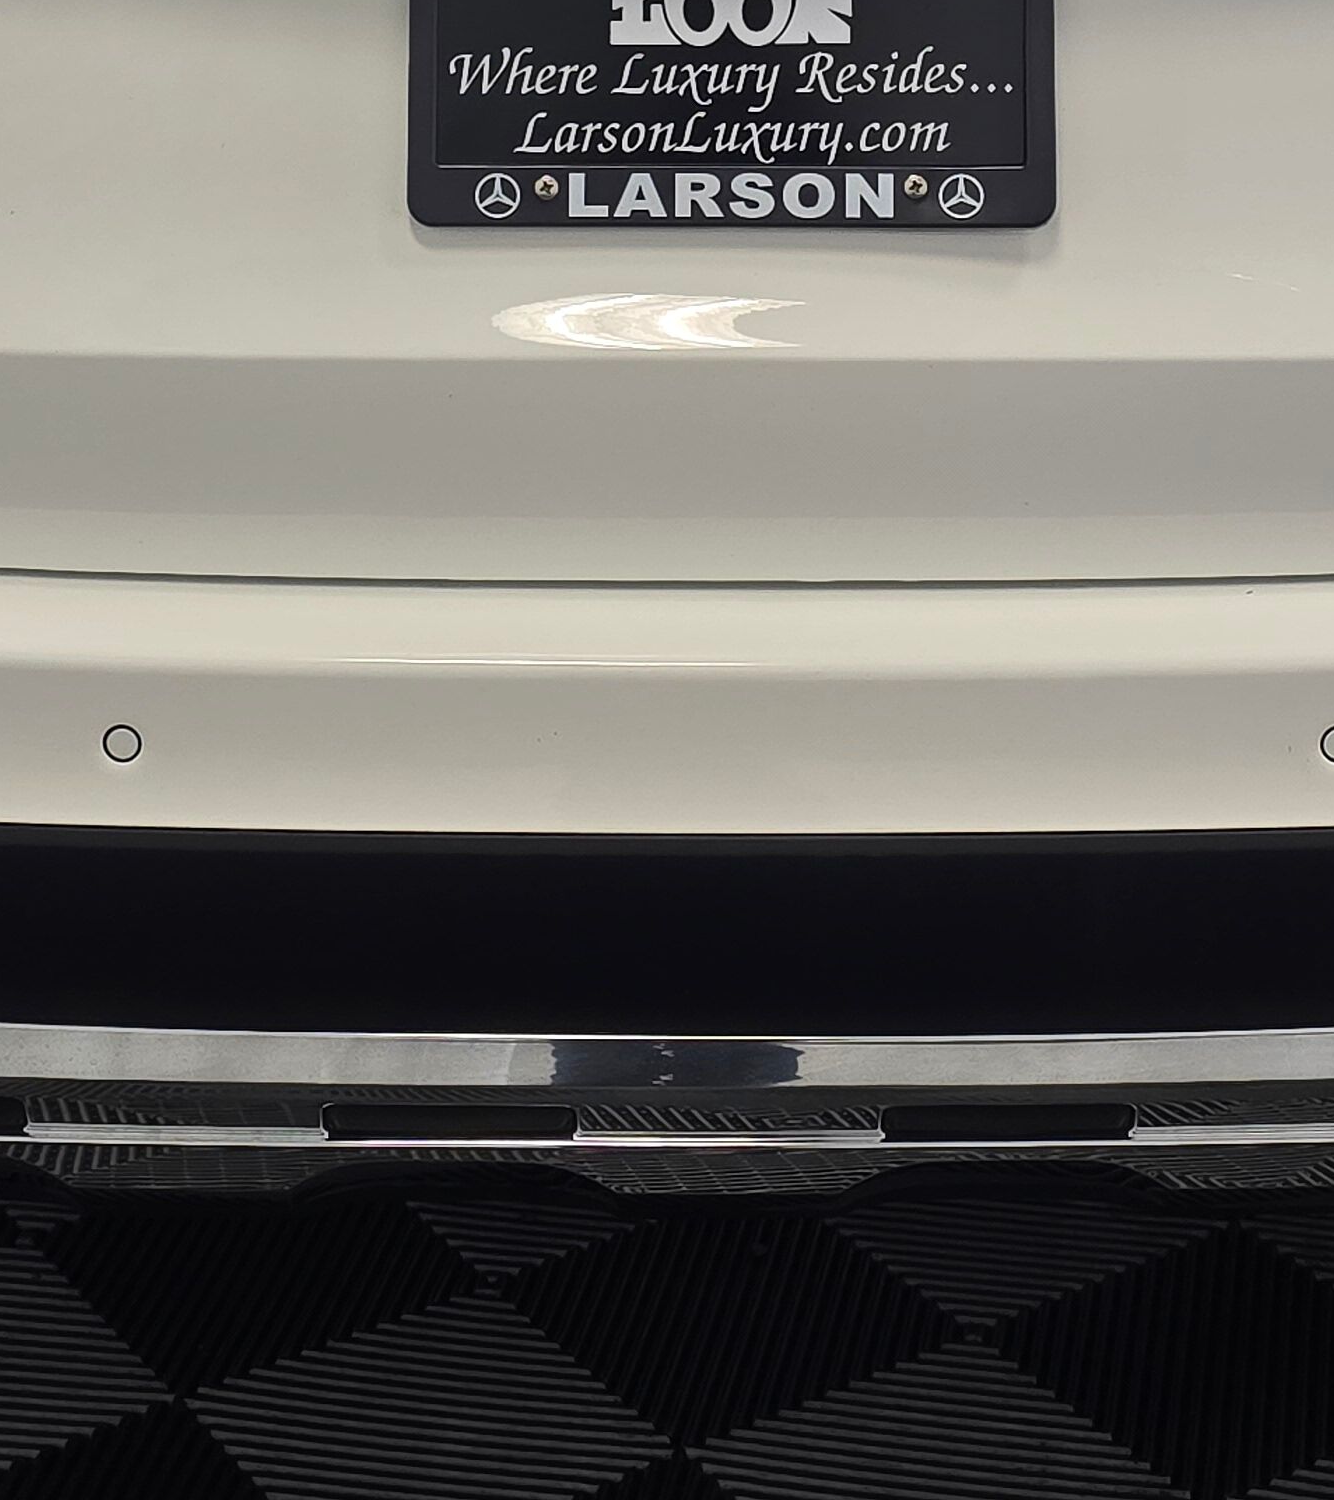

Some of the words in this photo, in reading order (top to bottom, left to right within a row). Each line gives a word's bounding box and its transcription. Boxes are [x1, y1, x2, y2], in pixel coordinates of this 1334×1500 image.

[448, 47, 598, 96] Where
[612, 53, 782, 112] Luxury
[795, 47, 1015, 103] Resides...
[513, 112, 951, 166] LarsonLuxury.com
[568, 173, 895, 219] LARSON
